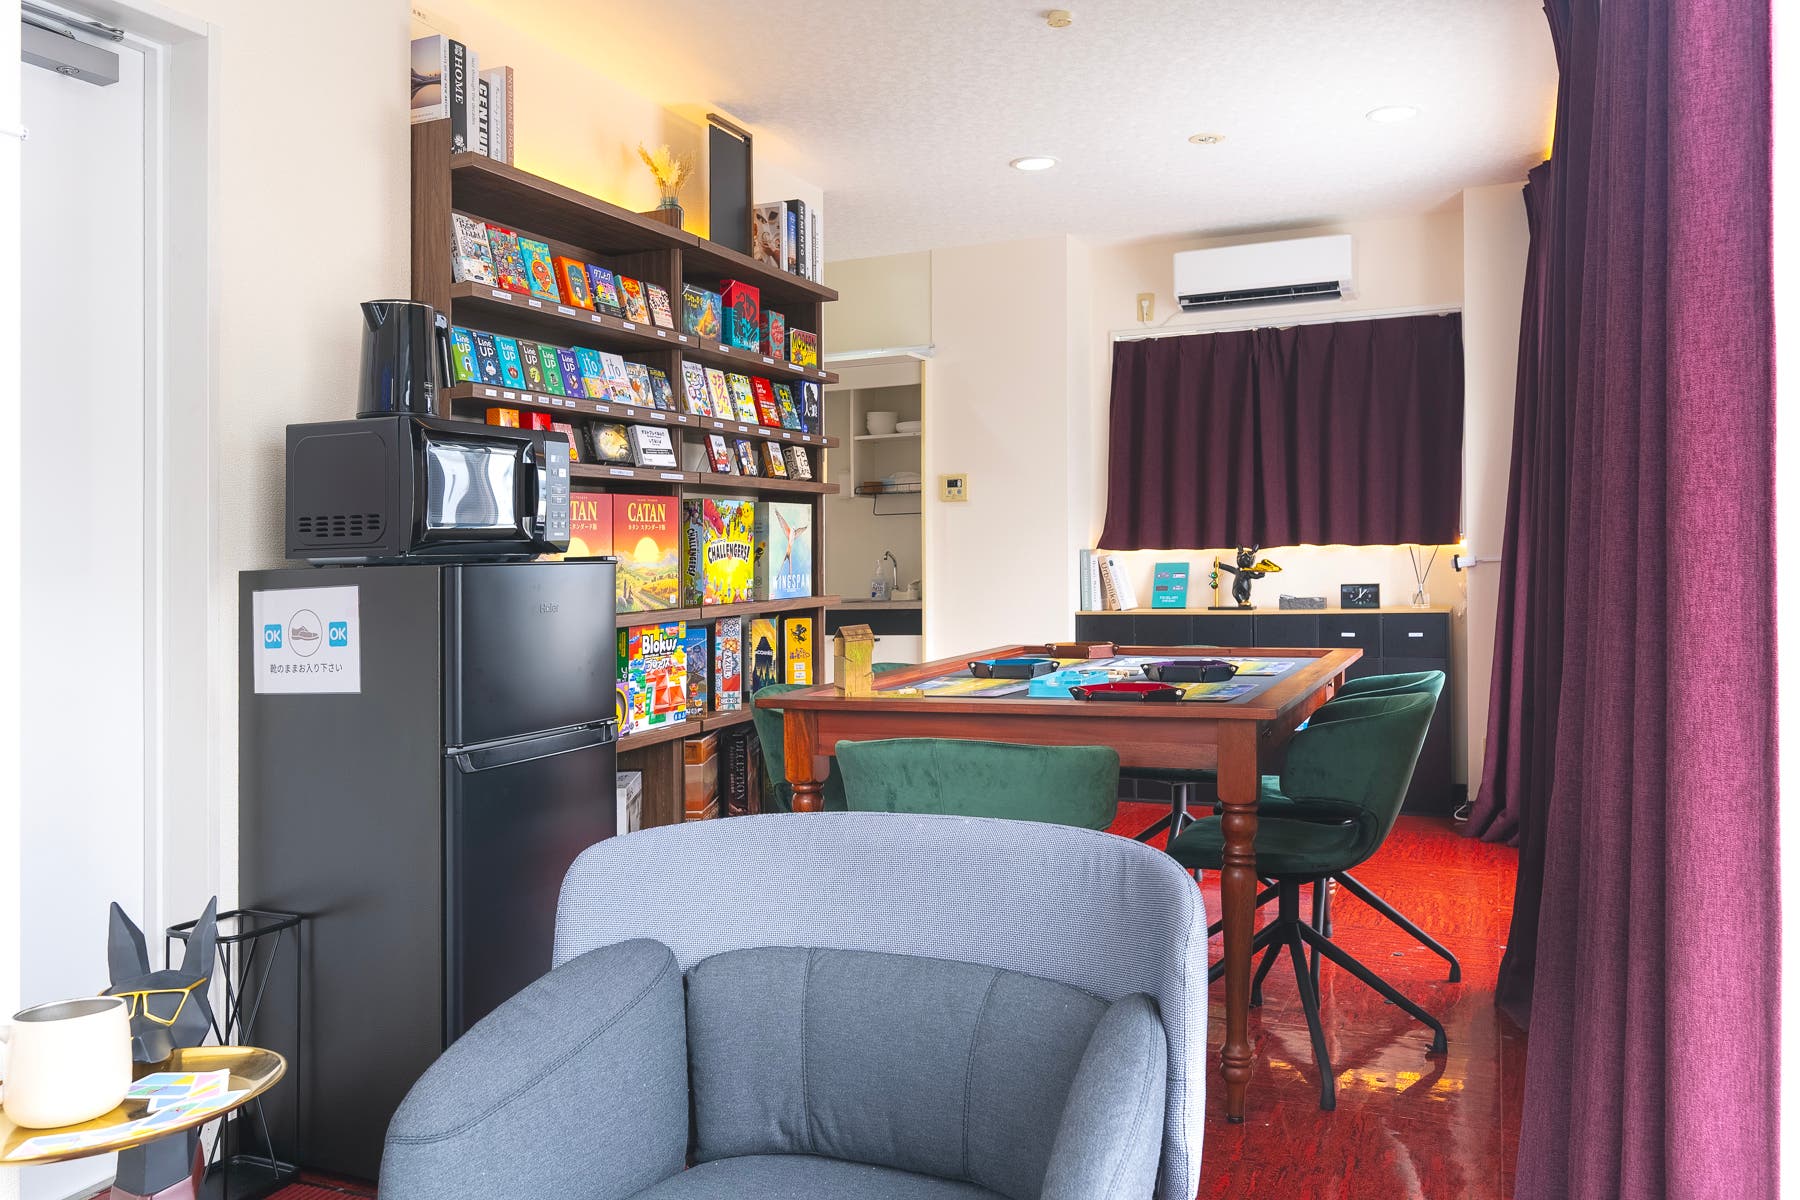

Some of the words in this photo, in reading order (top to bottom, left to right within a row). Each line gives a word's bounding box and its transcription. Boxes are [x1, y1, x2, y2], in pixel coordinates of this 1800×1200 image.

[455, 56, 464, 105] HOME
[455, 333, 470, 343] Line
[478, 338, 492, 347] Line
[501, 342, 514, 352] Line
[523, 346, 536, 356] Line
[542, 350, 554, 360] Line
[562, 354, 574, 364] Line
[570, 501, 598, 521] TAN
[628, 502, 666, 522] CATAN
[687, 528, 696, 577] CHALLENGERS!
[707, 543, 751, 564] CHALLENGERS!
[772, 574, 810, 589] WINGSPAN
[1100, 562, 1117, 605] Urbanlike
[266, 630, 281, 642] OK
[330, 627, 346, 640] OK
[642, 634, 678, 655] Blokus
[270, 664, 343, 674] 靴のままお入り下さい
